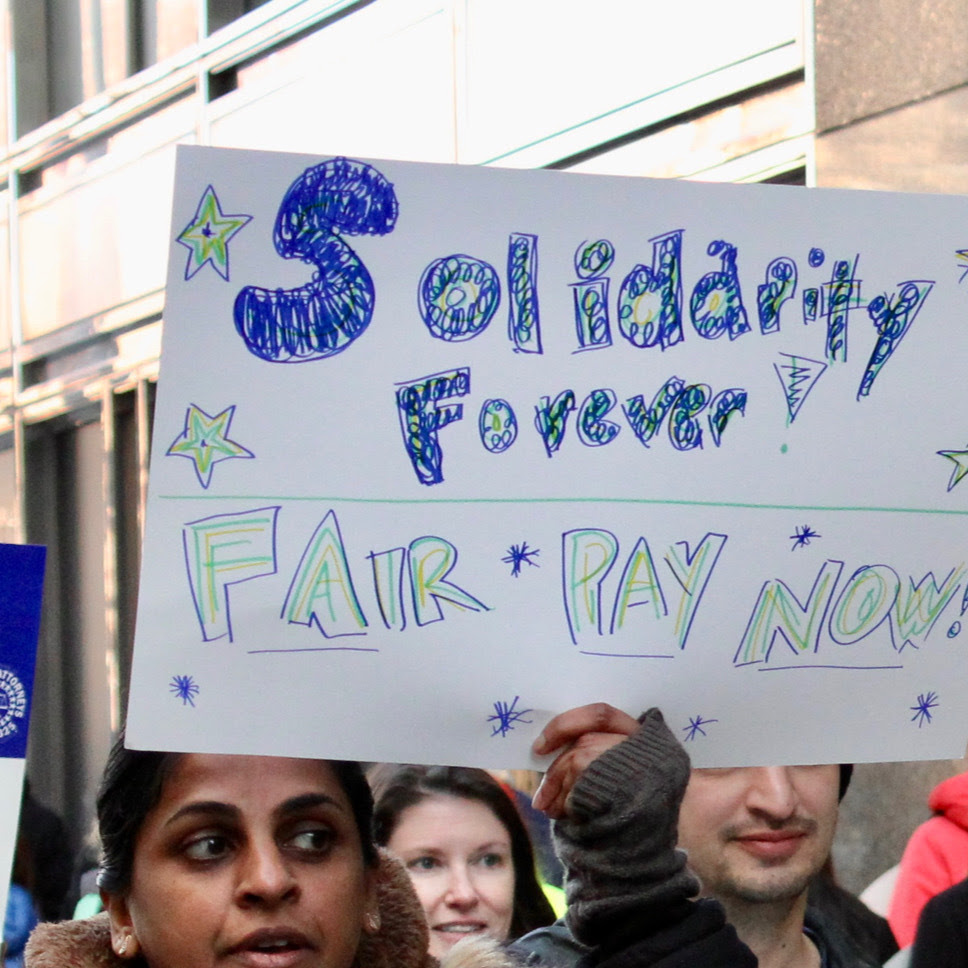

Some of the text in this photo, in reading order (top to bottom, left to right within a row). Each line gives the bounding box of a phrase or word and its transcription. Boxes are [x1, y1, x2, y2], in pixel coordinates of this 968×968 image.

[233, 156, 936, 402] Solidarity
[182, 505, 495, 643] FAIR
[562, 529, 728, 651] PAY
[0, 669, 26, 718] TTORNEYS
